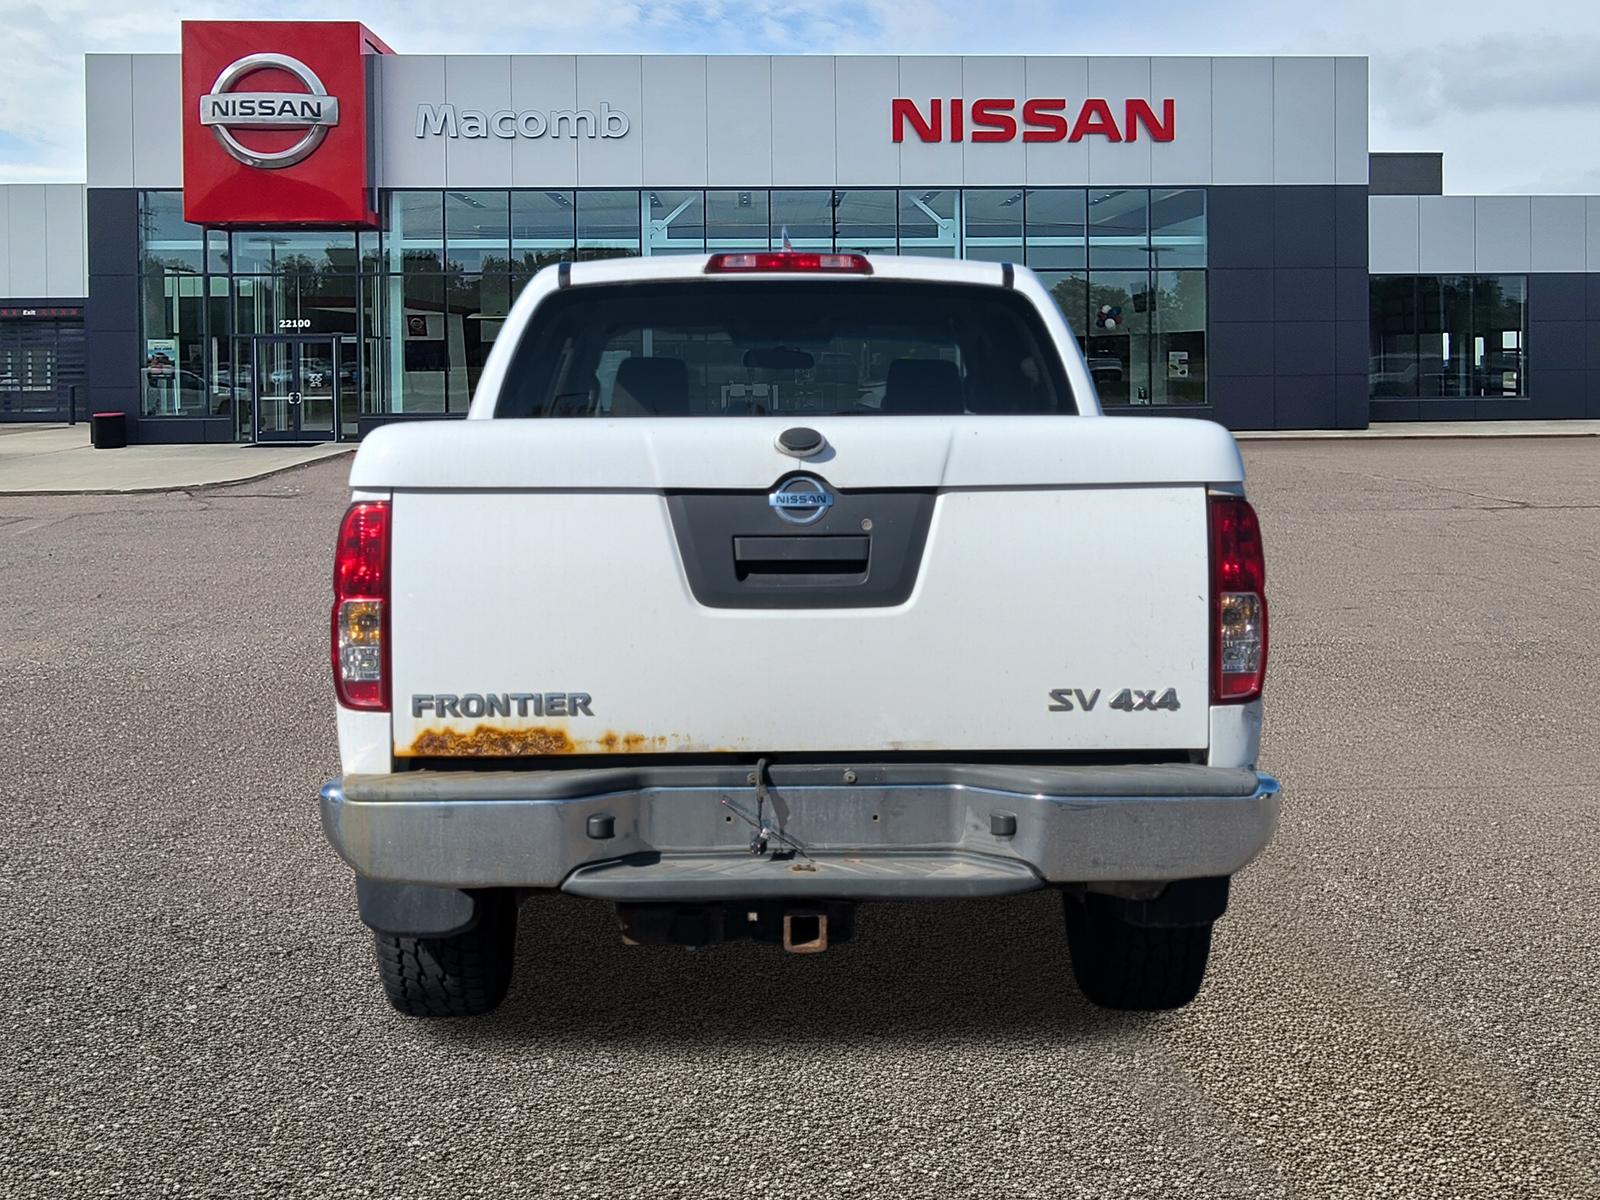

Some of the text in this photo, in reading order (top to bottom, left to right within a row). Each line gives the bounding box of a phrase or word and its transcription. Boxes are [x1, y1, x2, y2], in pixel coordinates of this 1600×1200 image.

[211, 100, 321, 118] NISSAN
[415, 102, 630, 139] Macomb
[892, 98, 1175, 143] NISSAN
[279, 319, 311, 328] 22100
[776, 495, 827, 504] NISSAN
[412, 692, 595, 718] FRONTIER
[1048, 688, 1101, 712] SV
